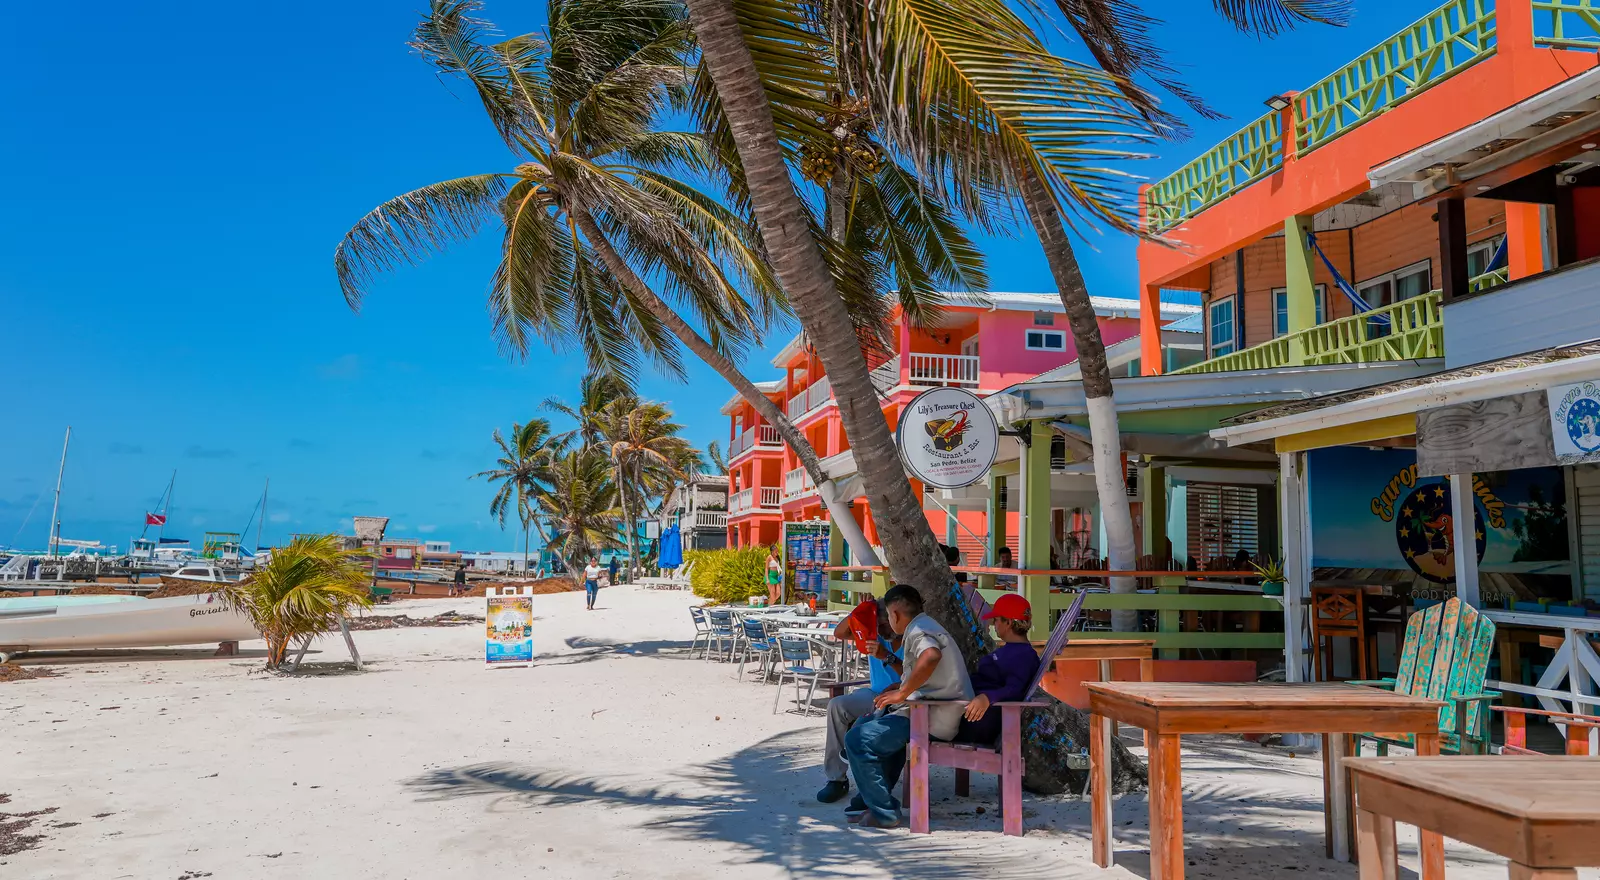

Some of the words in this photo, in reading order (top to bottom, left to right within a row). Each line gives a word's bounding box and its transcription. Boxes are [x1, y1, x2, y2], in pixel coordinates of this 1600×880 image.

[918, 405, 933, 415] Lily's
[934, 403, 959, 411] Treasure
[960, 401, 975, 410] Chest
[1555, 386, 1581, 424] Europe
[1583, 381, 1600, 400] Dr
[923, 443, 963, 459] Restaurant
[968, 439, 980, 451] Bar
[1371, 463, 1420, 522] Europ
[1406, 589, 1439, 600] OOD
[190, 606, 229, 618] Gaviota
